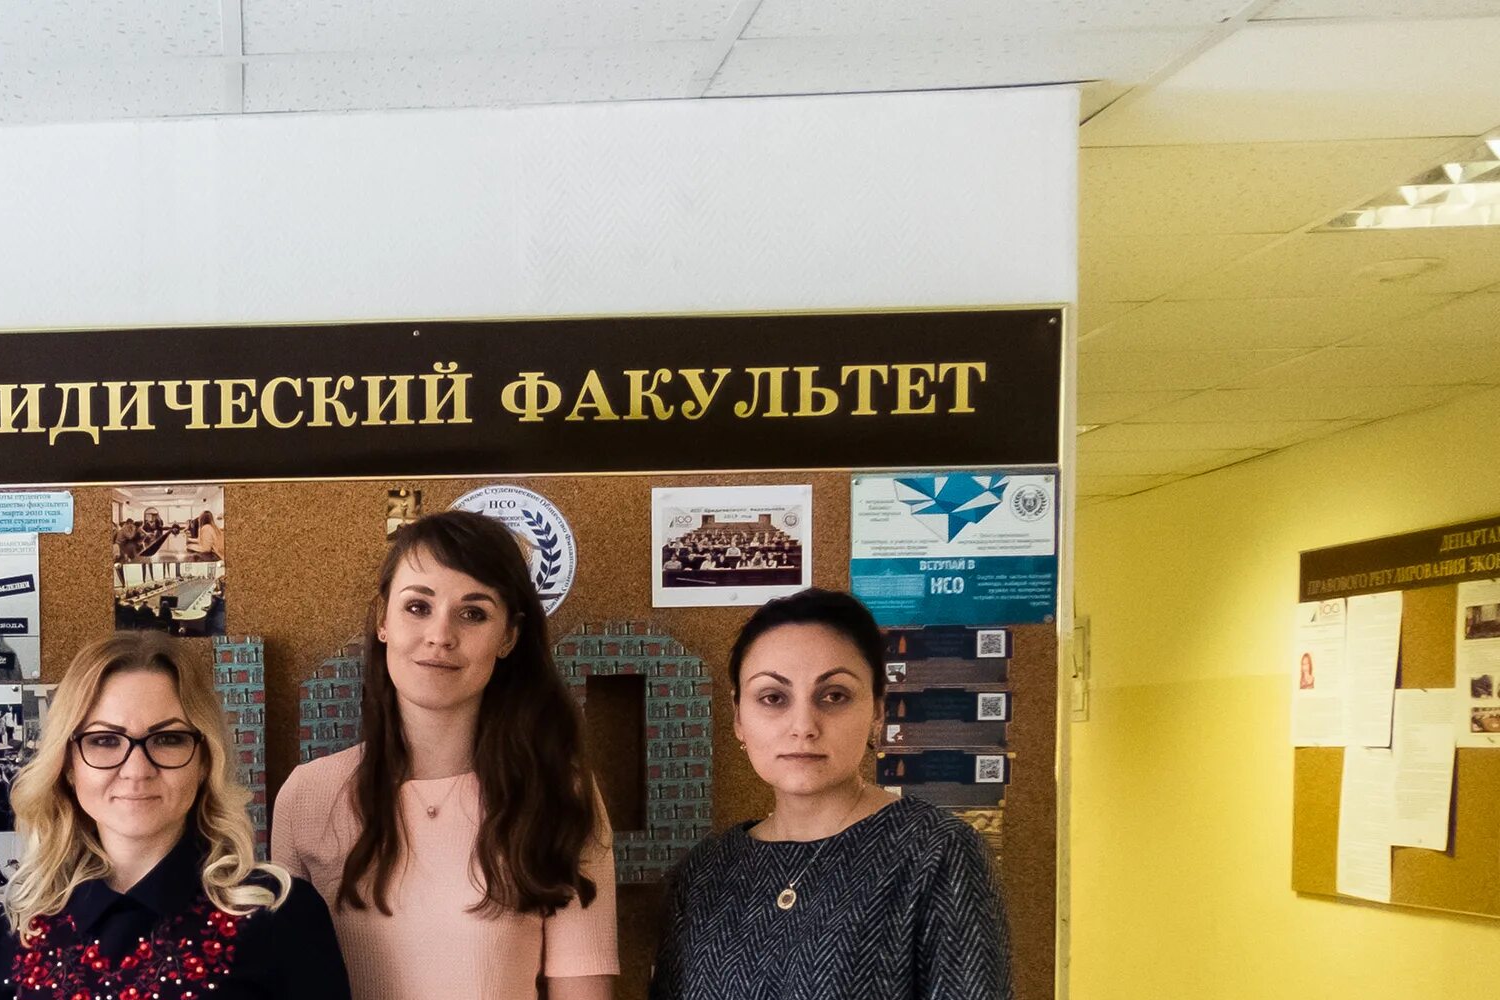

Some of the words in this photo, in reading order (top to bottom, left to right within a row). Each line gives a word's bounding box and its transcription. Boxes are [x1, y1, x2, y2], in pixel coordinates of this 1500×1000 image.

[501, 362, 987, 422] ФАКУЛЬТЕТ
[489, 500, 516, 509] НСО
[1440, 526, 1500, 552] ДЕПАРТА
[920, 558, 965, 571] ВСТУПАЙ
[967, 560, 976, 570] В
